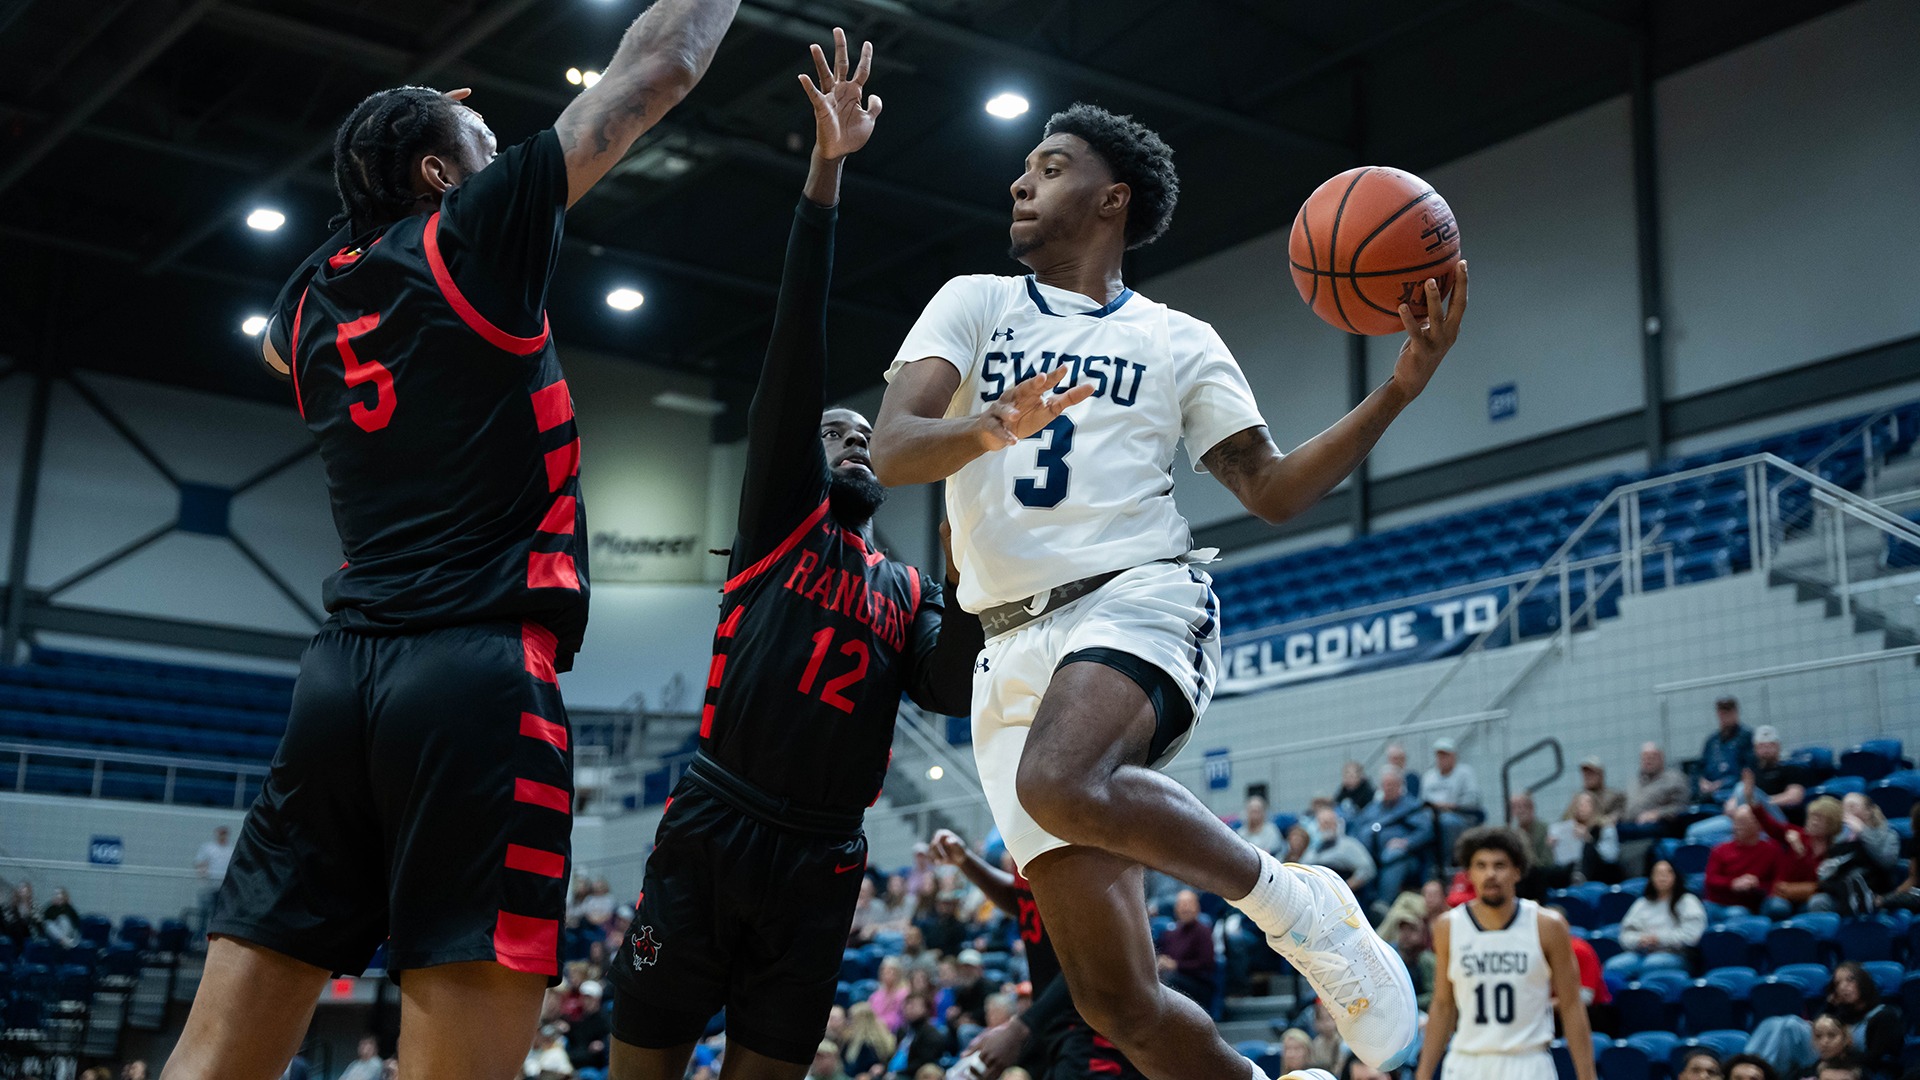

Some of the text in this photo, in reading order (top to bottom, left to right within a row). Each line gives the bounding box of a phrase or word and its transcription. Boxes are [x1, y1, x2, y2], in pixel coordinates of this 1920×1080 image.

[336, 312, 398, 433] 5
[981, 351, 1147, 407] SWOSU
[1012, 413, 1078, 511] 3
[1431, 594, 1499, 642] TO
[797, 626, 870, 715] 12
[1460, 952, 1528, 978] SWOSU
[1475, 983, 1515, 1025] 10
